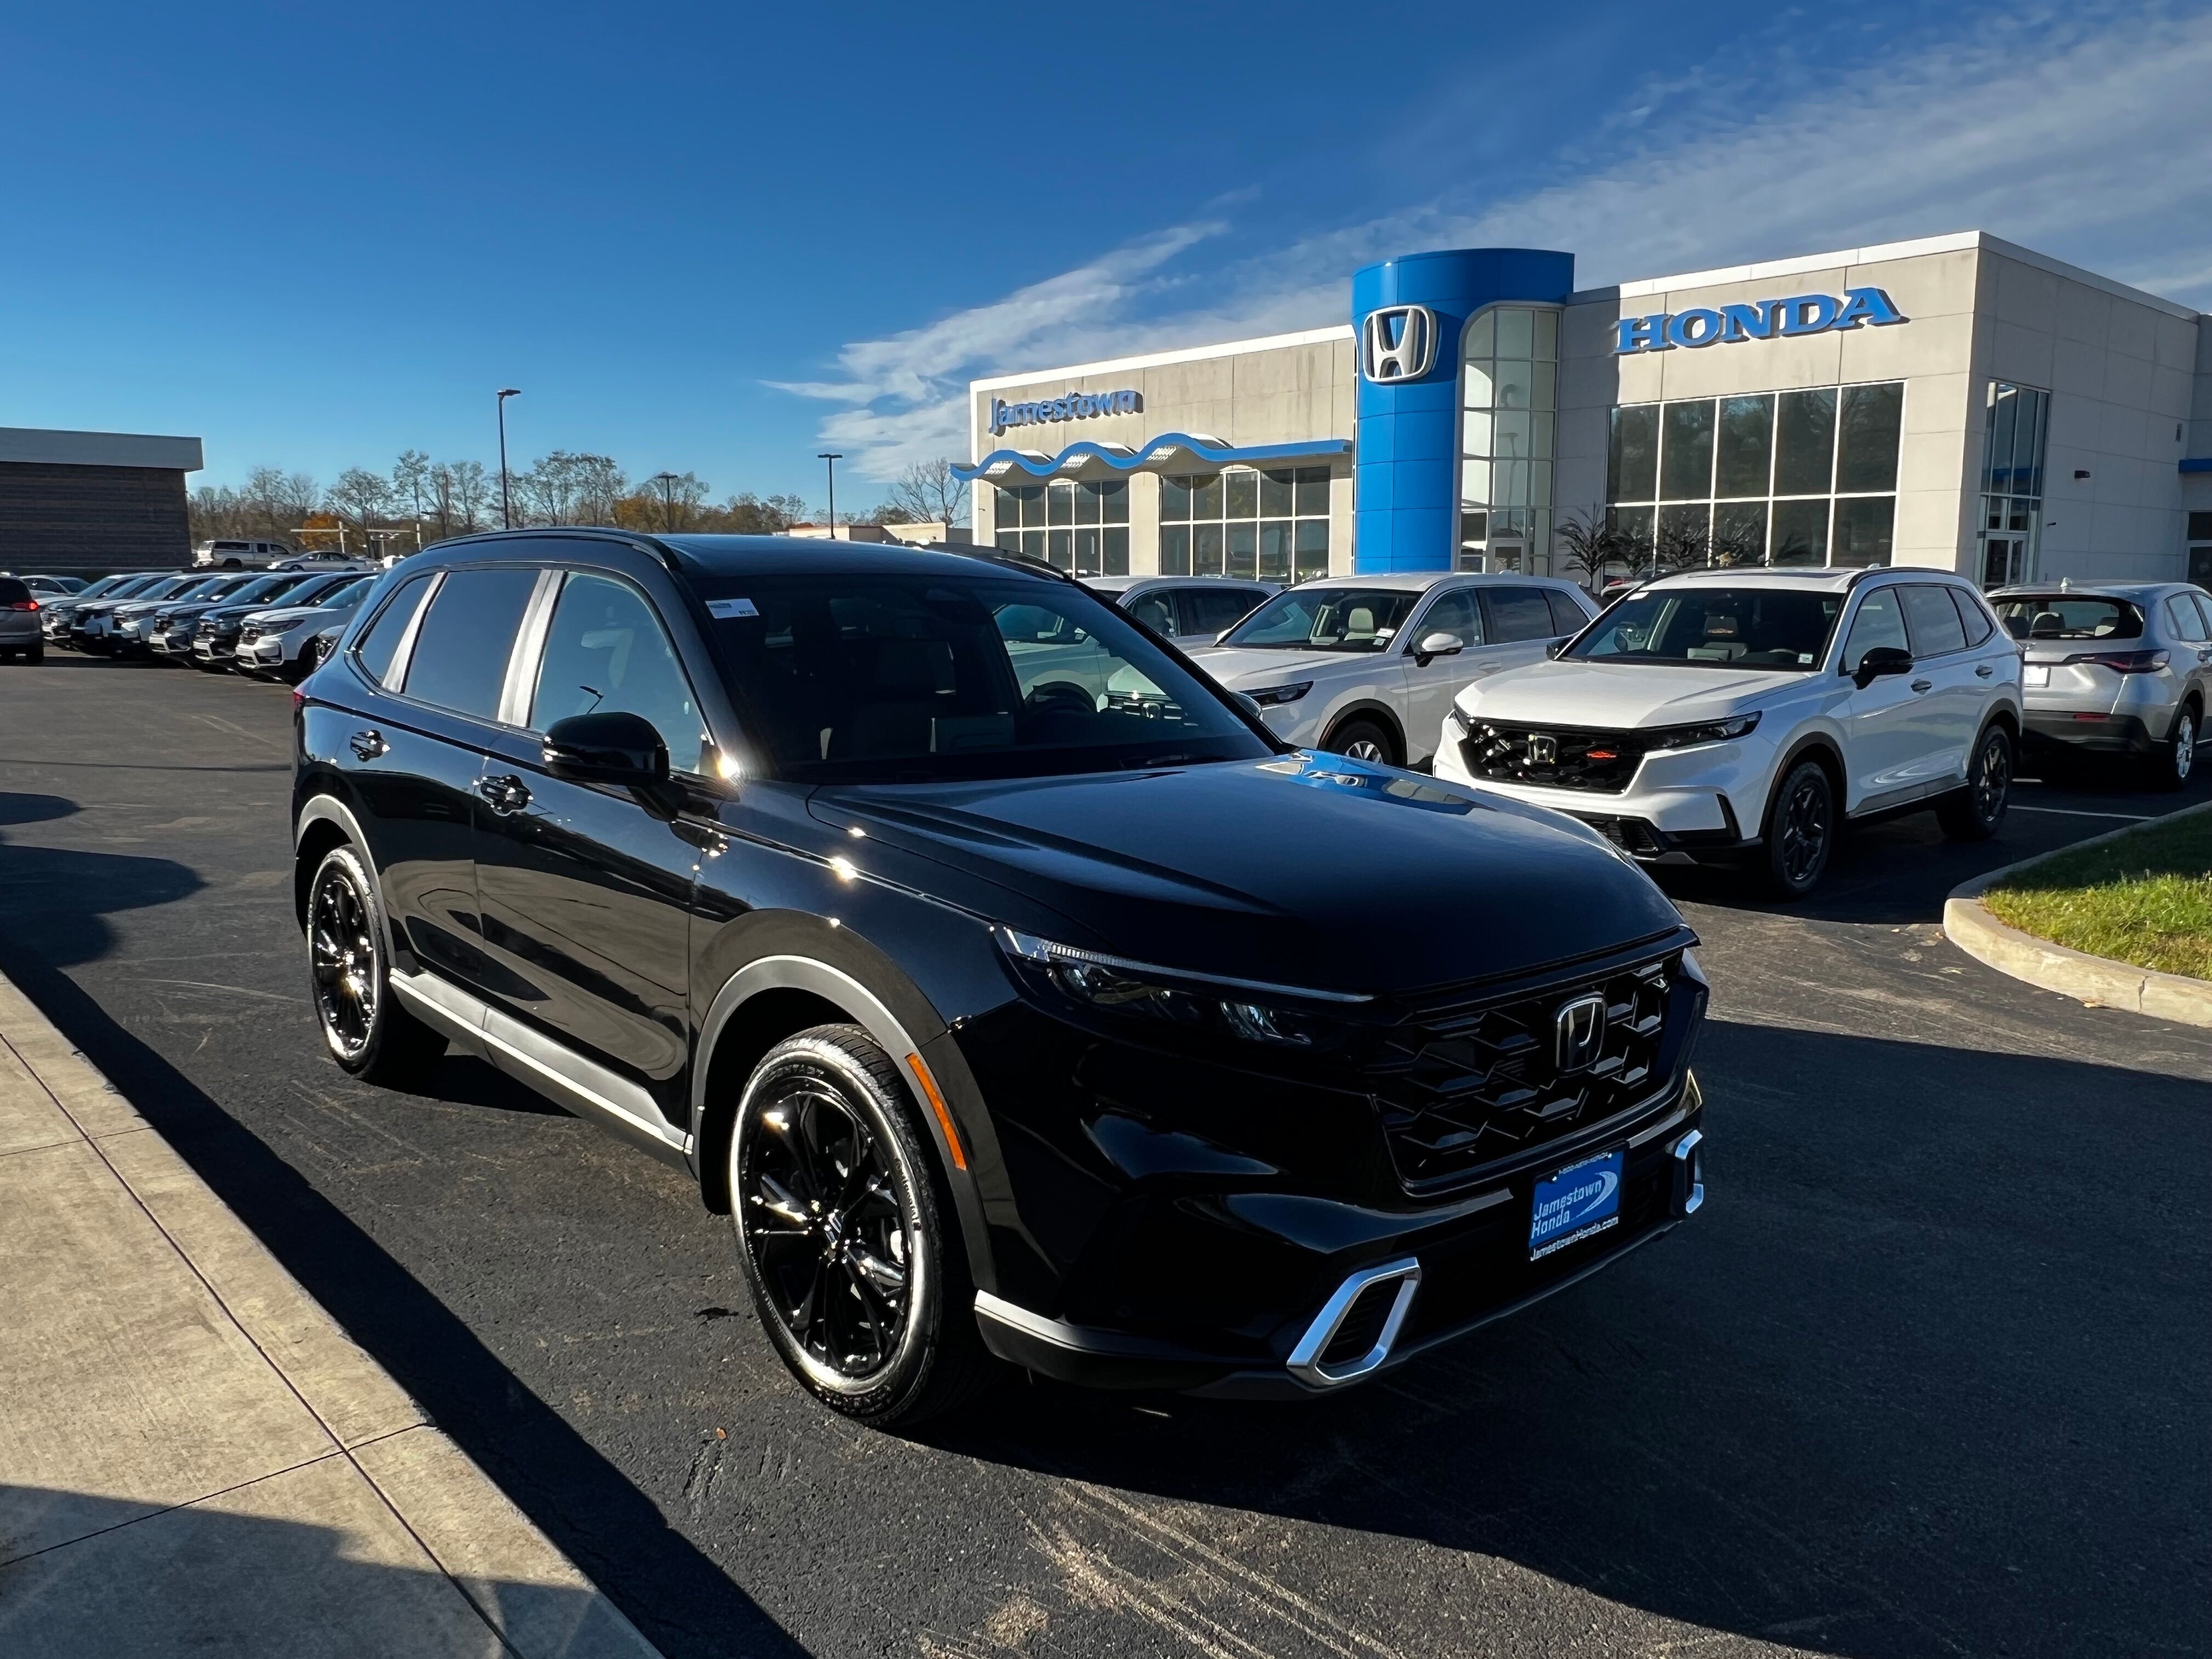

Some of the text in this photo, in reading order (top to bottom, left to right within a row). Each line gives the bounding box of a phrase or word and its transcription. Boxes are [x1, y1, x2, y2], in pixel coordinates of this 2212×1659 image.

[1613, 287, 1901, 356] HONDA
[989, 391, 1143, 437] Jamestown
[1533, 1180, 1602, 1221] Jamestown
[1531, 1208, 1570, 1239] Honda
